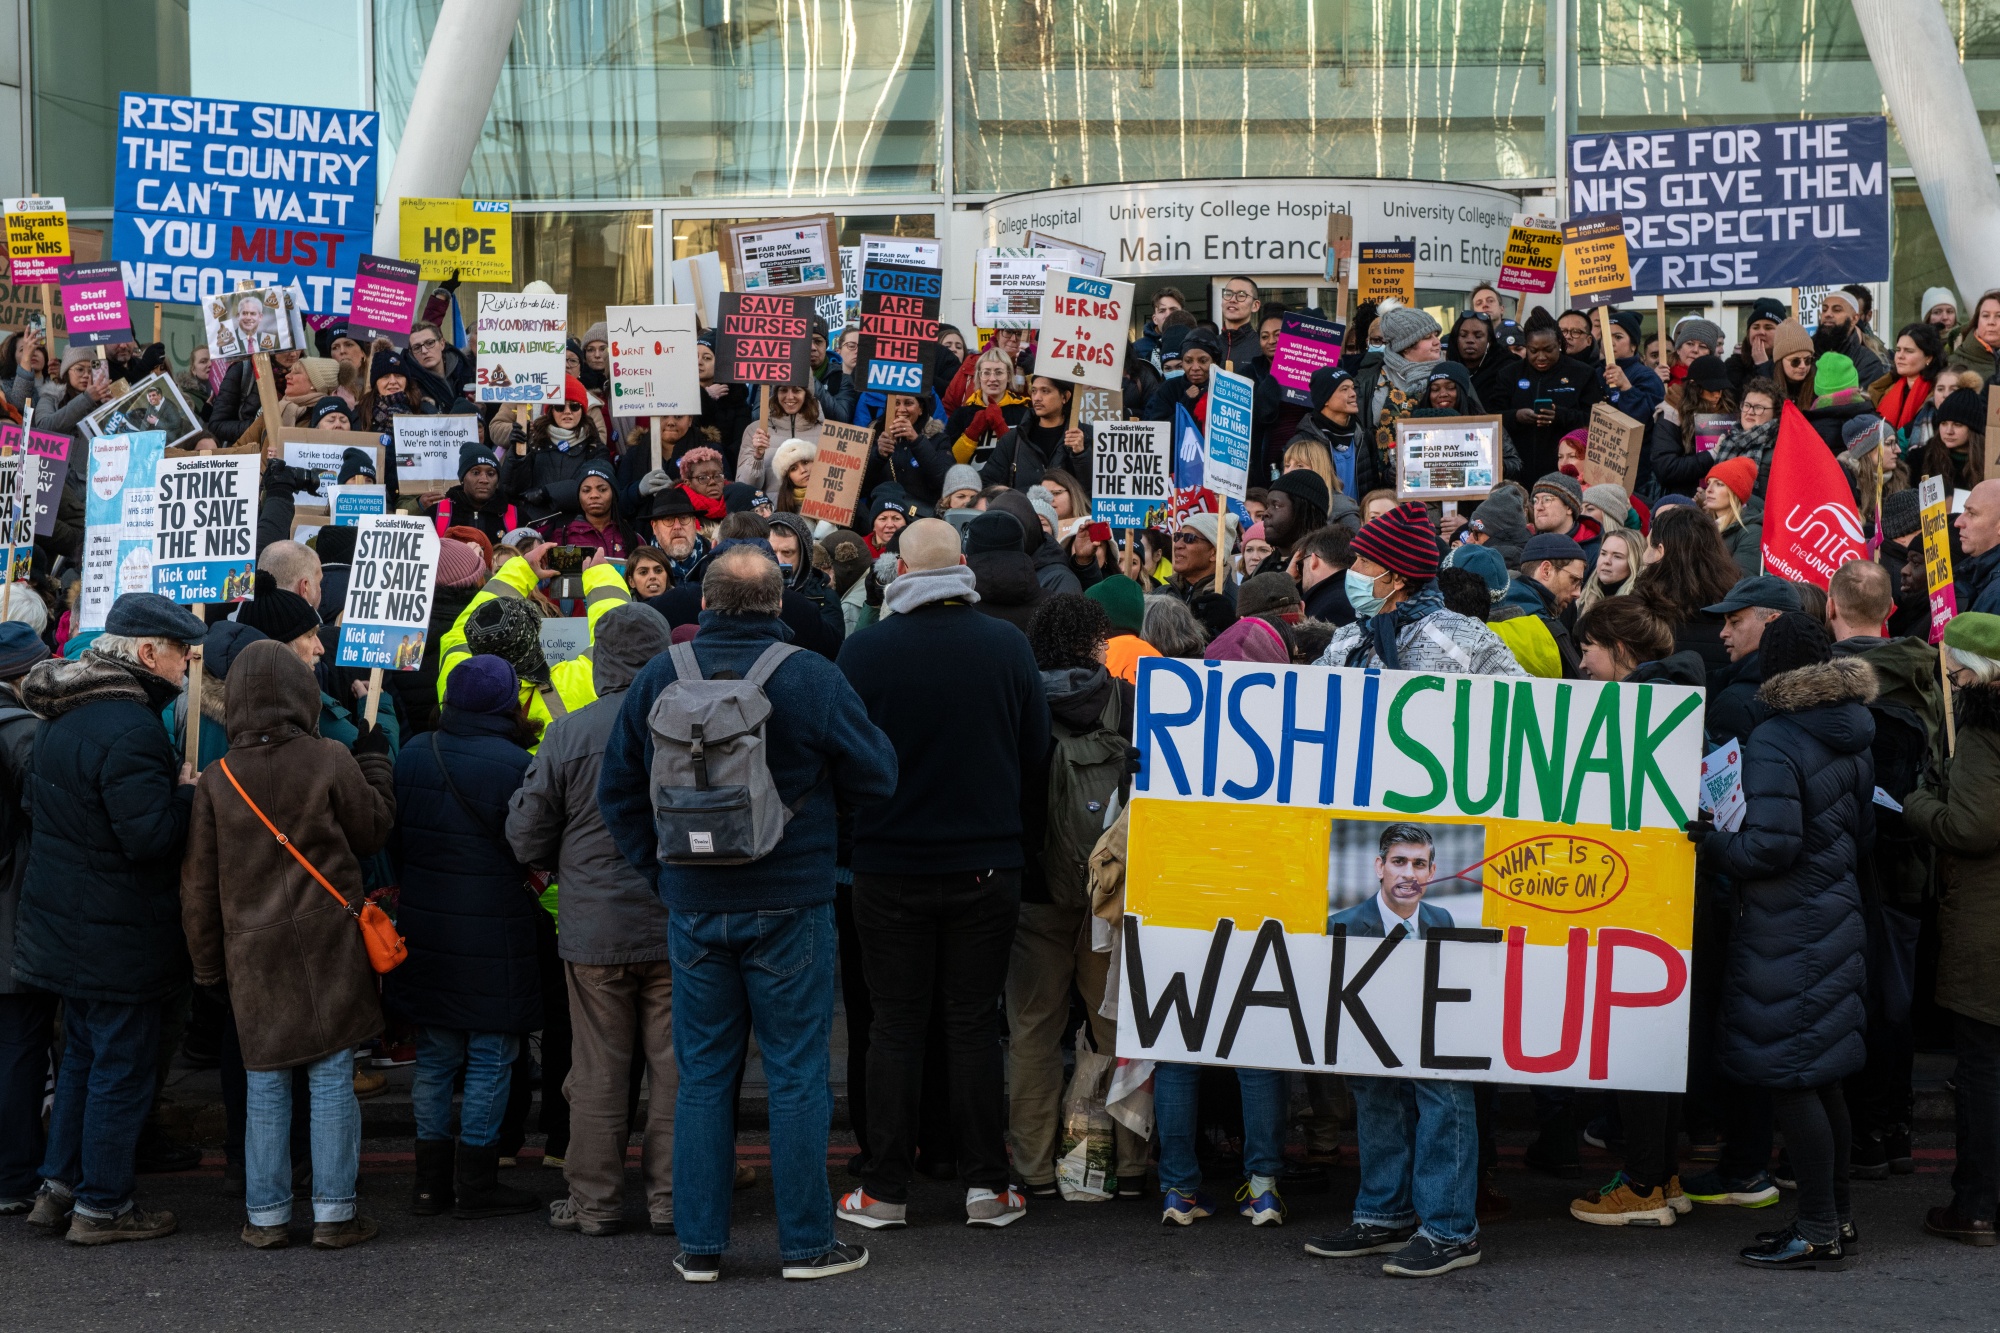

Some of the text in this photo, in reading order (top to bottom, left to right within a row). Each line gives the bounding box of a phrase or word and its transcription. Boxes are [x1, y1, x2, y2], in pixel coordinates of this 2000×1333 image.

[124, 96, 375, 147] RISHI SUNAK
[1573, 124, 1848, 173] CARE FOR THE
[122, 136, 370, 186] THE COUNTRY
[1574, 162, 1883, 213] NHS GIVE THEM
[136, 178, 354, 226] CAN'T WAIT
[474, 201, 509, 213] NHS
[1109, 200, 1351, 222] University College Hospital
[9, 215, 64, 230] Migrants
[997, 207, 1081, 235] College Hospital
[1383, 201, 1496, 229] University College
[1623, 204, 1861, 249] RESPECTFUL
[11, 230, 44, 242] make
[133, 217, 345, 268] YOU MUST
[424, 226, 496, 254] HOPE
[1511, 229, 1563, 246] Migrants
[12, 241, 62, 255] our NHS
[758, 243, 792, 253] FAIR PAY
[776, 247, 811, 257] NURSING
[1119, 235, 1191, 262] Main
[1508, 243, 1540, 256] make
[1574, 242, 1616, 256] It's time
[1506, 256, 1553, 268] our NHS
[1581, 254, 1611, 266] to pay
[92, 266, 117, 274] STAFFING
[1503, 268, 1532, 278] Stop the
[1578, 263, 1617, 276] nursing
[1662, 251, 1758, 289] RISE
[867, 272, 940, 295] TORIES
[1075, 281, 1107, 296] NHS
[1501, 275, 1546, 288] scapegoating
[1574, 272, 1625, 287] staff fairly
[81, 289, 107, 300] Staff
[481, 293, 518, 313] Rishi's
[519, 298, 540, 309] to-do
[69, 301, 122, 313] shortages
[741, 297, 793, 315] SAVE
[881, 297, 922, 315] ARE
[1055, 295, 1121, 321] HEROES
[73, 311, 121, 322] cost lives
[726, 317, 806, 338] NURSES
[860, 316, 939, 338] KILLING
[1075, 325, 1091, 341] to
[612, 341, 675, 357] BURNT OUT
[737, 341, 789, 358] SAVE
[876, 339, 919, 359] THE
[1051, 337, 1115, 367] ZEROES
[515, 372, 549, 385] ON THE
[613, 362, 652, 377] BROKEN
[735, 363, 791, 381] LIVES
[868, 363, 922, 388] NHS
[481, 385, 544, 401] NURSES
[614, 382, 655, 397] BROKE!!!
[104, 410, 124, 435] NHS
[1221, 405, 1242, 422] SAVE
[400, 428, 469, 439] Enough is enough
[1110, 424, 1134, 432] Socialist
[1213, 414, 1248, 437] OUR NHS!
[403, 439, 451, 448] We're not in
[837, 427, 869, 445] RATHER
[1097, 432, 1155, 454] STRIKE
[298, 450, 343, 461] Strike today
[836, 440, 847, 453] BE
[176, 460, 239, 471] Socialist Worker
[818, 450, 861, 471] NURSING
[1097, 453, 1162, 476] TO SAVE
[827, 465, 846, 479] BUT
[159, 470, 239, 502] STRIKE
[822, 477, 843, 492] THIS
[1096, 475, 1165, 497] THE NHS
[337, 497, 383, 505] HEALTH WORKERS
[824, 490, 836, 503] IS
[158, 499, 249, 530] TO SAVE
[801, 498, 853, 524] IMPORTANT
[1097, 501, 1134, 513] Kick out
[375, 519, 426, 531] Socialist Worker
[1113, 514, 1141, 526] Tories
[156, 527, 251, 560] THE NHS
[1785, 502, 1861, 568] unite
[358, 530, 424, 561] STRIKE
[158, 567, 183, 584] Kick
[187, 566, 207, 581] out
[354, 560, 430, 592] TO SAVE
[180, 584, 217, 600] Tories
[349, 590, 428, 622] THE NHS
[345, 627, 385, 645] Kick out
[546, 638, 576, 650] College
[342, 646, 391, 664] the Tories
[1137, 656, 1703, 832] RISHI SUNAK
[1490, 838, 1587, 878] WHAT IS
[1509, 855, 1616, 899] GOING ON?
[1124, 915, 1687, 1081] WAKE UP
